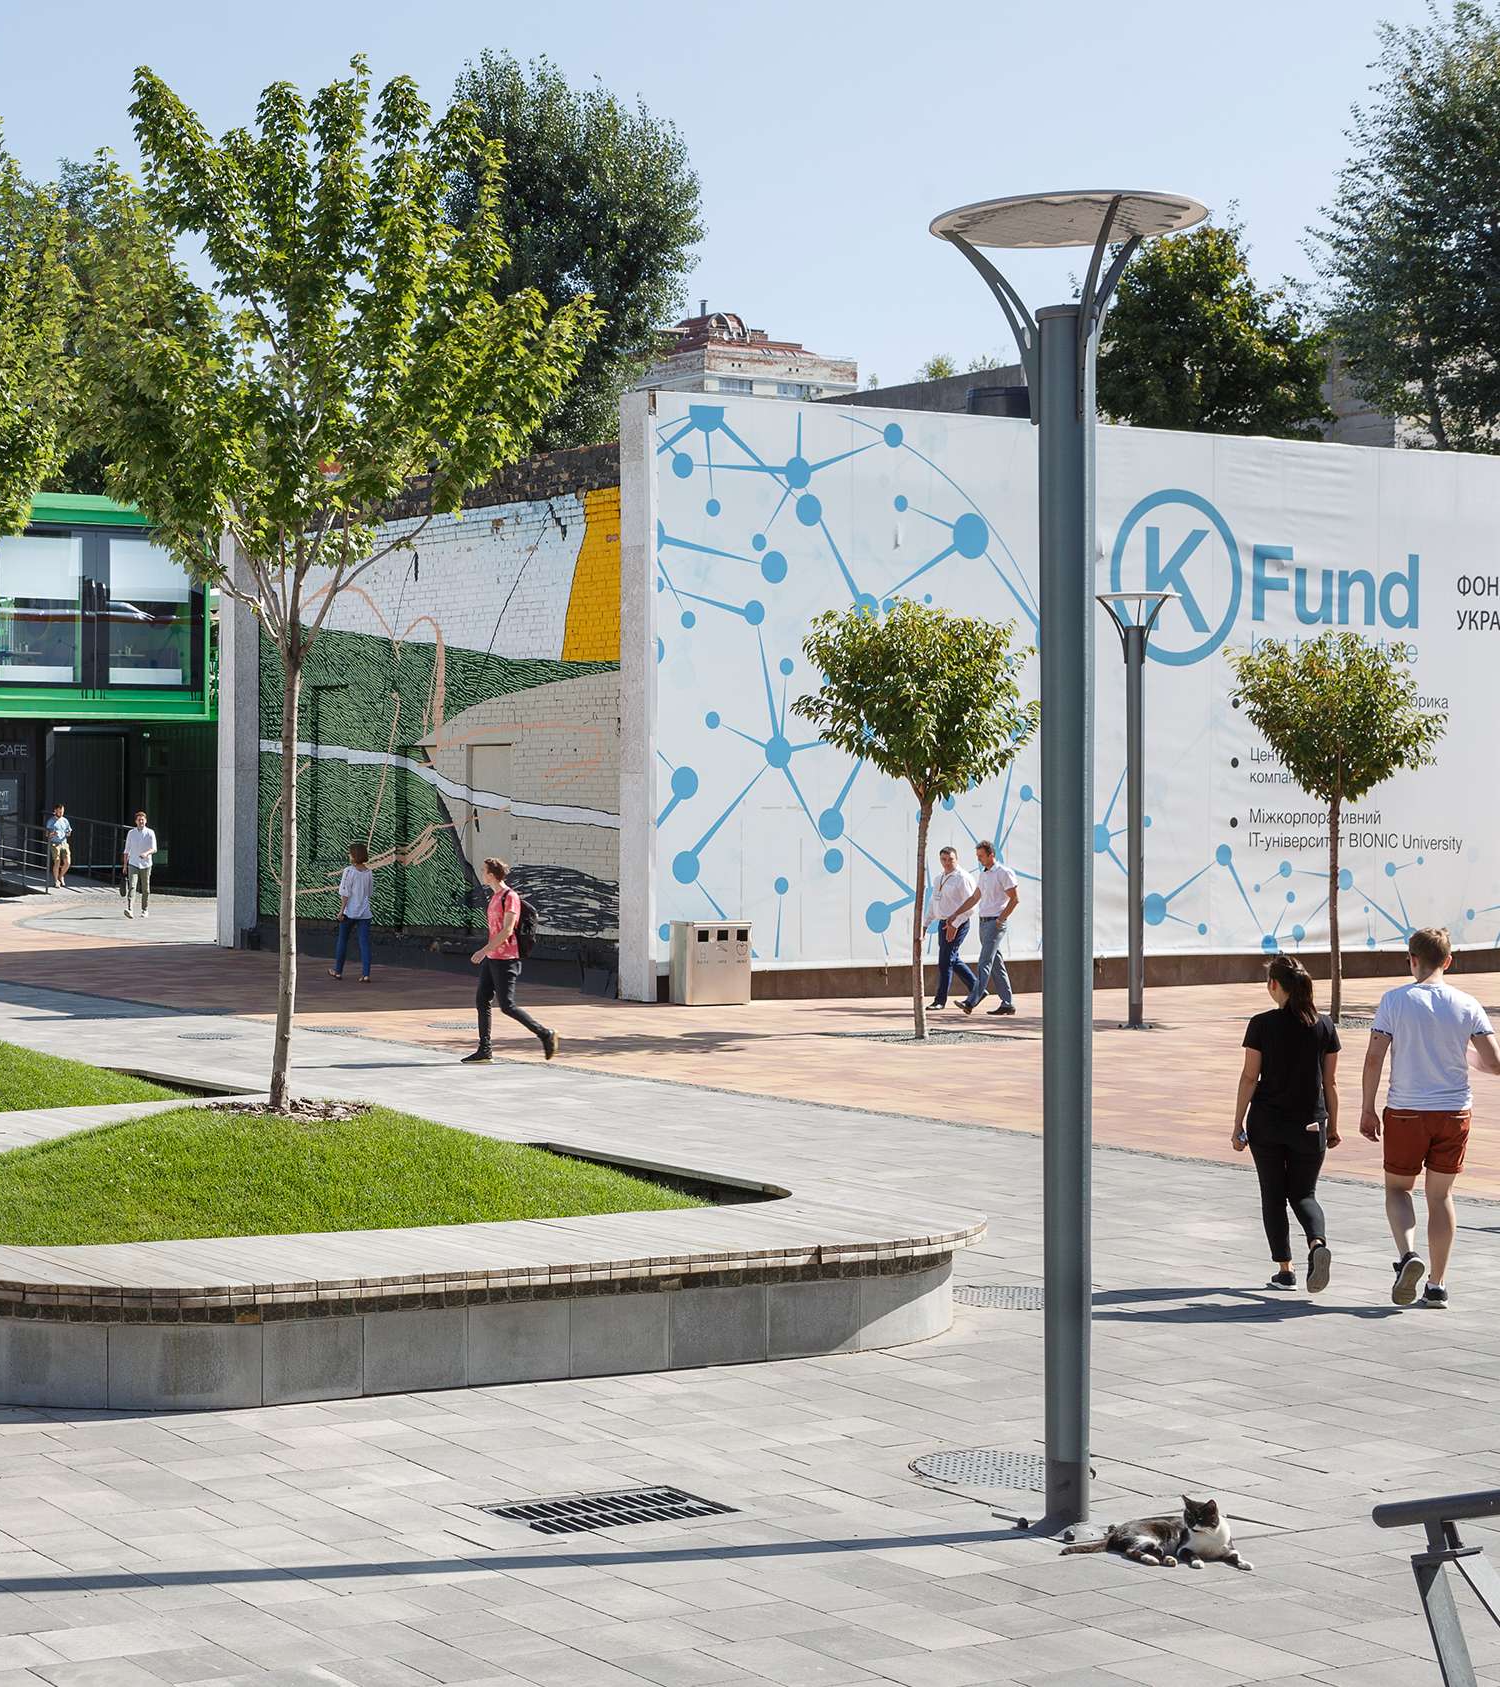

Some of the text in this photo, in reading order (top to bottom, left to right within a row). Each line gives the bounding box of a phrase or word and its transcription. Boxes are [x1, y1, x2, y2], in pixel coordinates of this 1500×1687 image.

[1252, 543, 1419, 630] Fund
[1249, 808, 1381, 828] Міжкорпораивний
[1248, 831, 1463, 854] ІТ-університт BIONIC University
